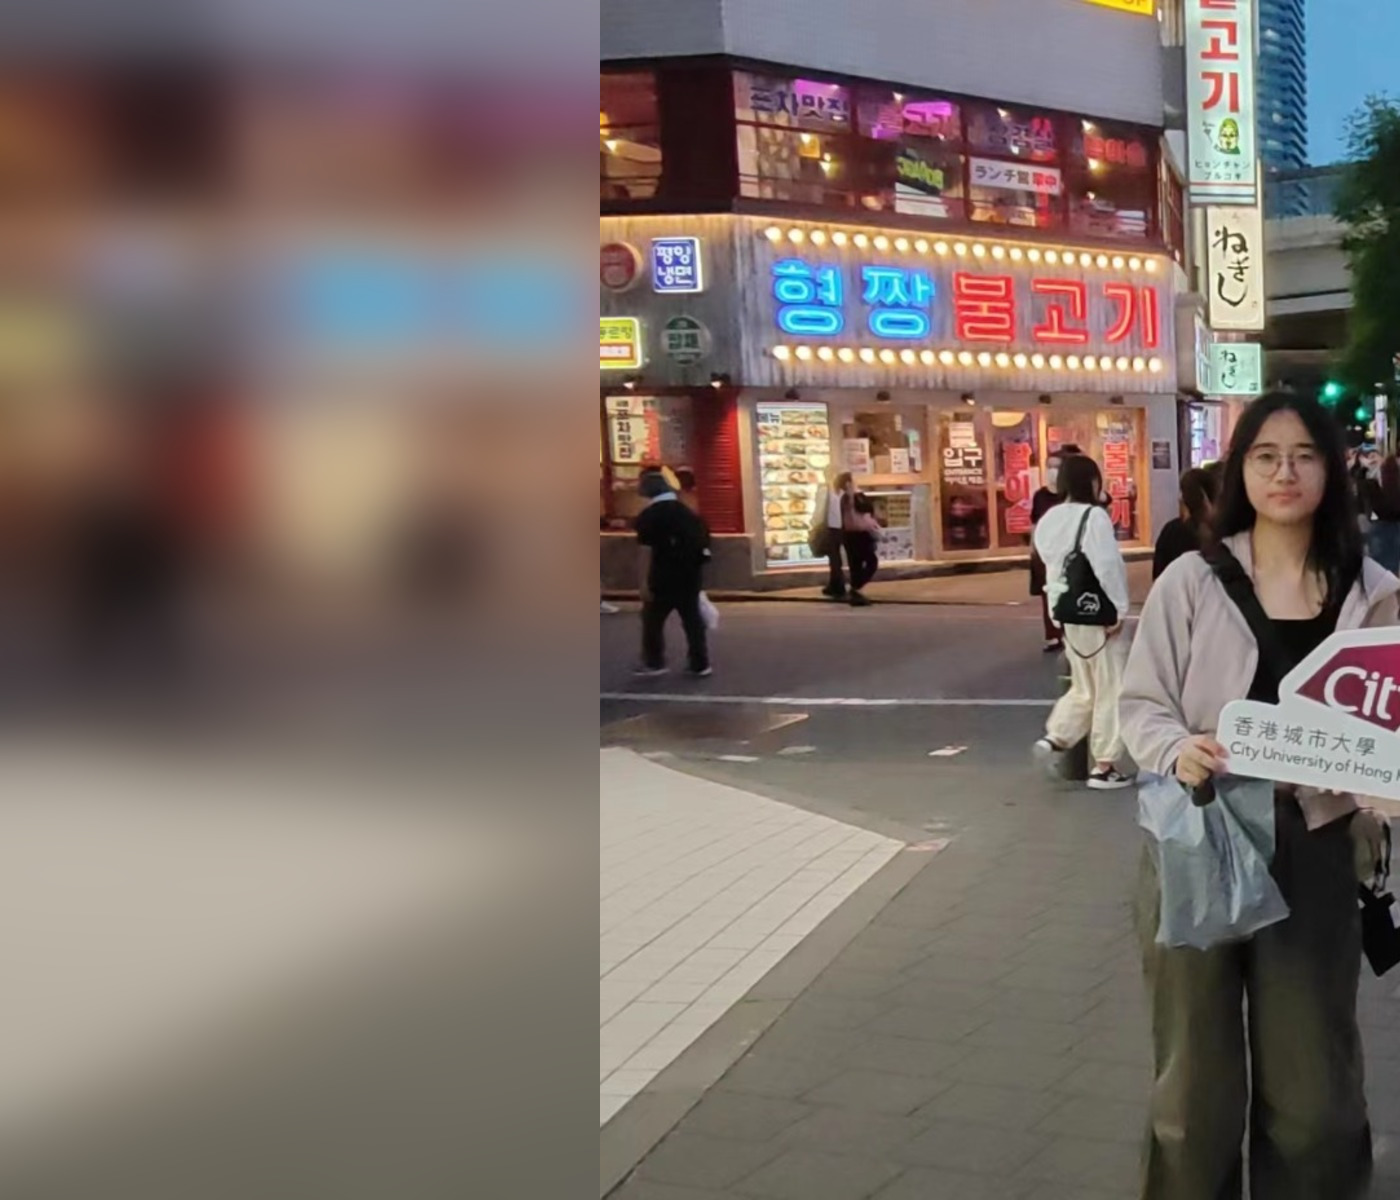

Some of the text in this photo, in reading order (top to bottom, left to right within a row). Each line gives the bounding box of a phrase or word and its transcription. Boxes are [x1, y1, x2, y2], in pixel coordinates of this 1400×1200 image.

[1199, 0, 1240, 113] 고기
[656, 246, 692, 265] 평양
[657, 265, 693, 286] 냉면
[1212, 225, 1251, 307] ねぎし
[943, 448, 983, 467] 입구
[1103, 442, 1131, 529] 불고기
[1234, 716, 1376, 756] 香港城市大學
[1230, 741, 1261, 761] City
[1262, 747, 1333, 773] University
[1335, 760, 1351, 772] of
[1353, 762, 1393, 783] Hong
